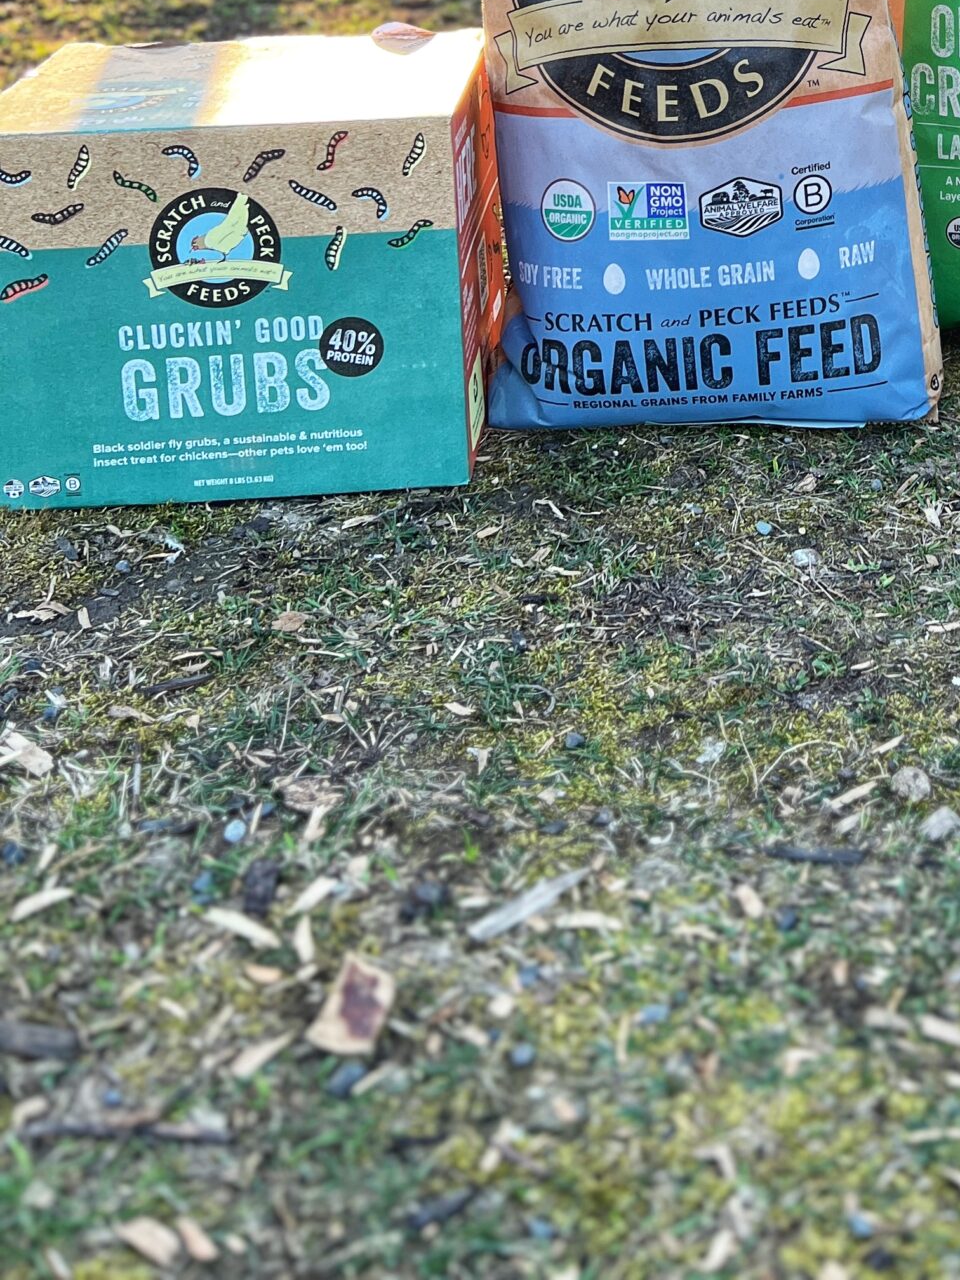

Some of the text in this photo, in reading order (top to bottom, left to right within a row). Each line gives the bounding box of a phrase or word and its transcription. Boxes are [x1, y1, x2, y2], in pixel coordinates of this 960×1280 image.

[525, 27, 552, 48] You
[558, 21, 584, 35] are
[592, 10, 639, 28] what
[646, 12, 697, 31] your
[706, 7, 784, 24] animals
[586, 59, 764, 122] FEEDS
[791, 161, 831, 176] Certified
[650, 185, 682, 197] NON
[945, 176, 953, 186] A
[553, 193, 582, 209] USDA
[651, 196, 683, 208] GMO
[803, 182, 824, 208] B
[549, 211, 587, 225] ORGANIC
[650, 207, 683, 217] Project
[704, 200, 779, 214] ANIMAL WELFARE
[719, 208, 765, 218] APPROVED
[156, 195, 206, 263] SCRATCH
[250, 214, 274, 258] PECK
[615, 219, 684, 229] VERIFIED
[794, 213, 834, 226] Corporation
[610, 230, 689, 240] nongmoproject.org
[838, 240, 876, 269] RAW
[518, 261, 583, 290] SOY FREE
[645, 260, 775, 291] WHOLE GRAIN
[187, 281, 251, 302] FEEDS
[254, 315, 323, 344] GOOD
[544, 312, 652, 333] SCRATCH
[660, 314, 692, 328] and
[699, 305, 761, 327] PECK
[328, 328, 376, 356] 40%
[326, 350, 374, 366] PROTEIN
[520, 333, 733, 396] ORGANIC
[755, 313, 882, 386] FEED
[120, 348, 330, 422] GRUBS
[573, 387, 823, 410] REGIONAL GRAINS FROM FAMILY FARMS
[92, 443, 125, 454] Black
[127, 441, 165, 452] soldier
[168, 439, 182, 450] fly
[185, 437, 221, 449] grubs,
[233, 432, 297, 445] sustainable
[299, 431, 307, 440] &
[310, 428, 363, 440] nutritious
[130, 454, 157, 465] treat
[160, 453, 176, 463] for
[270, 446, 294, 458] pets
[297, 444, 320, 454] love
[345, 441, 367, 451] too!
